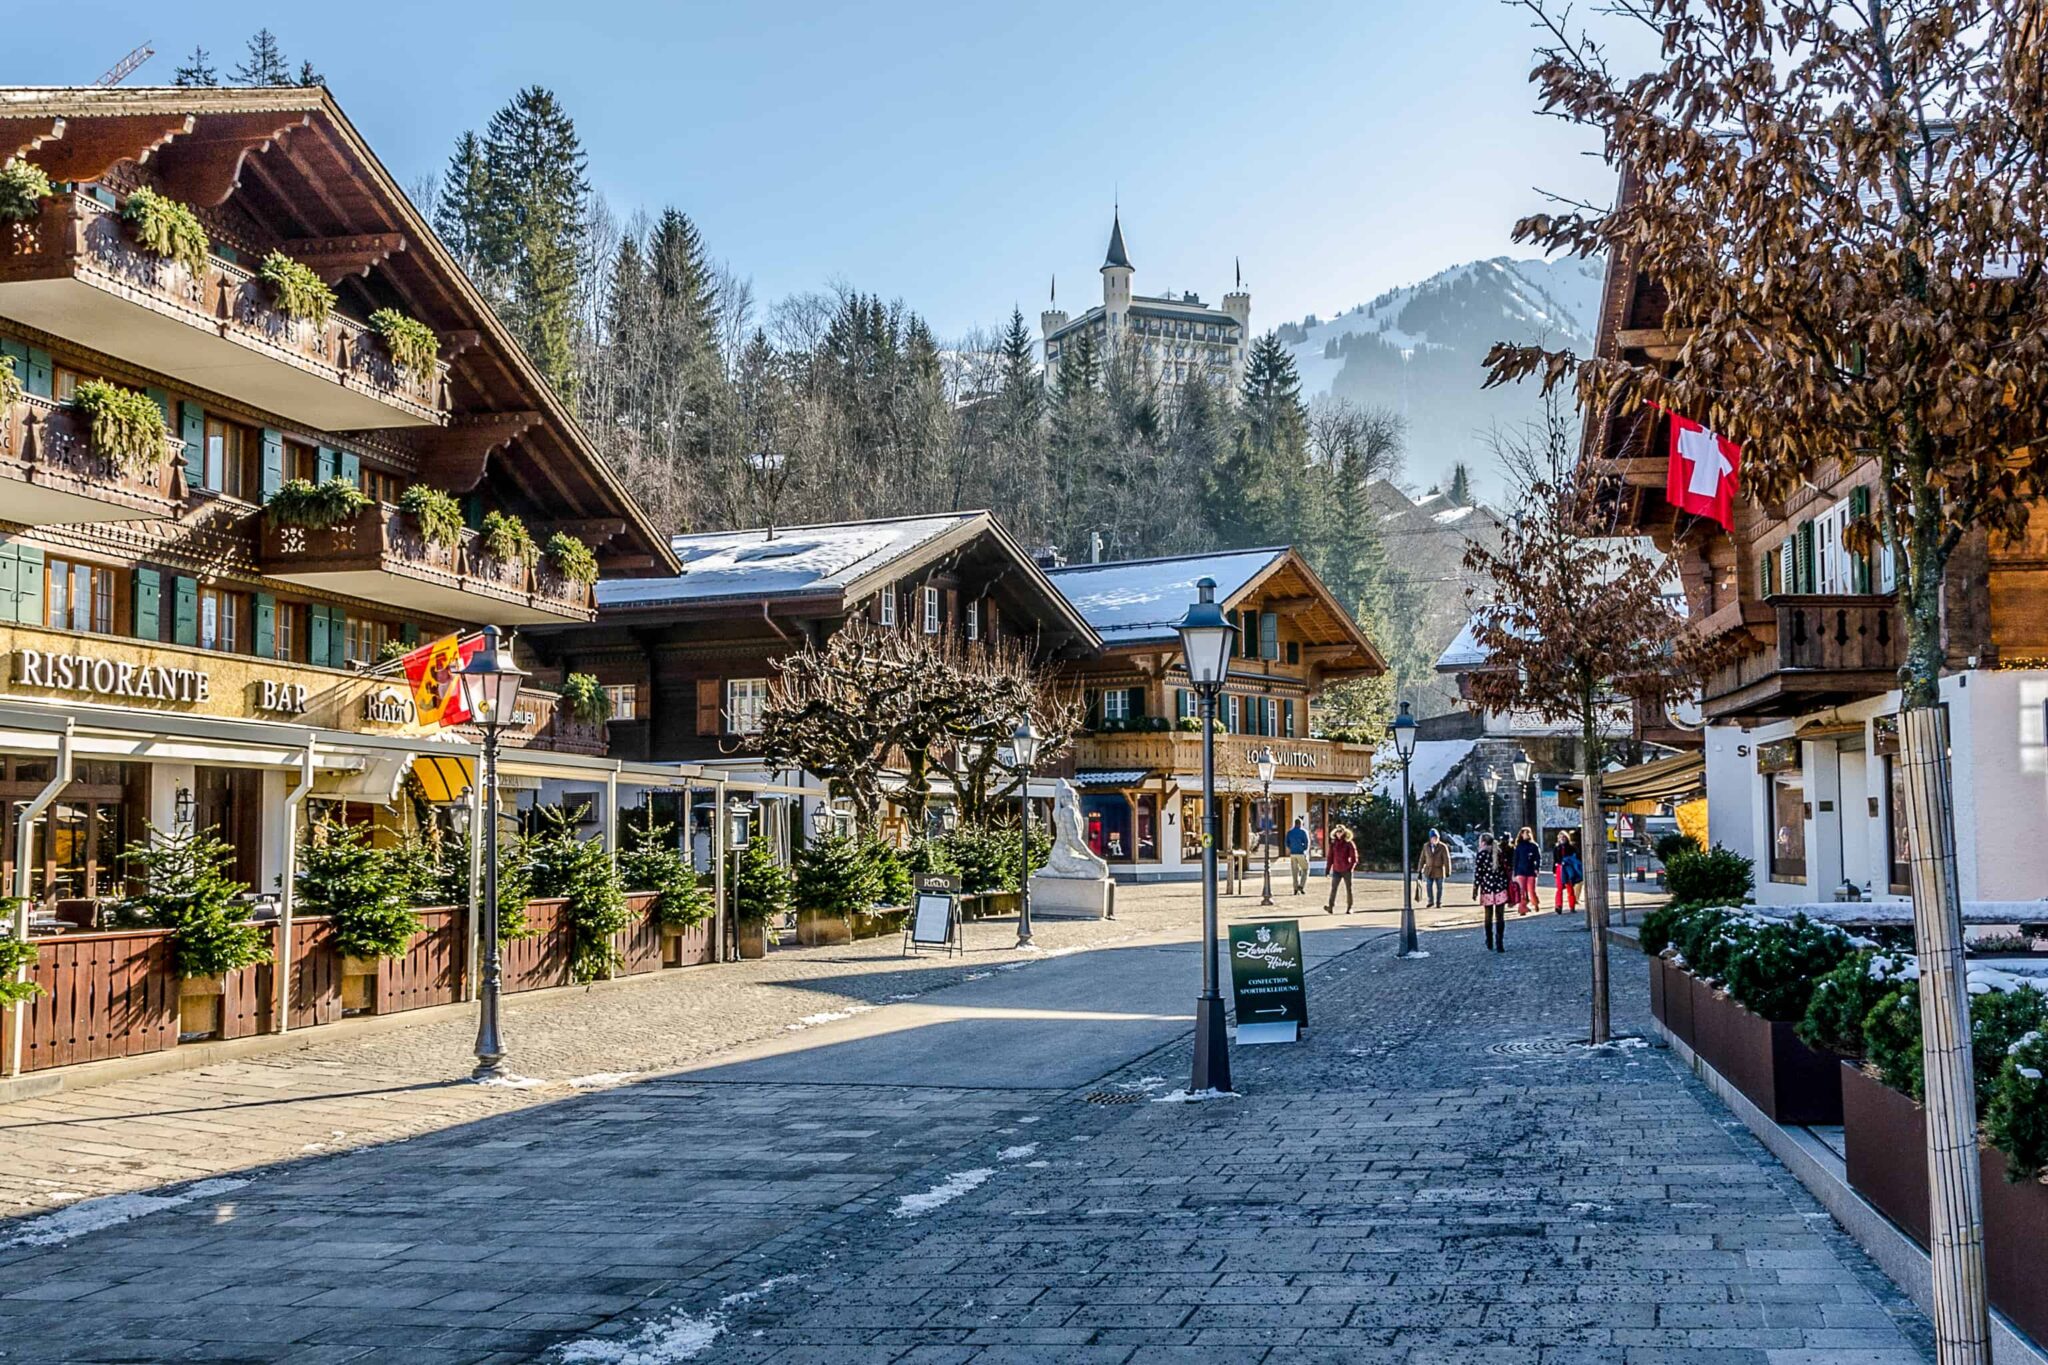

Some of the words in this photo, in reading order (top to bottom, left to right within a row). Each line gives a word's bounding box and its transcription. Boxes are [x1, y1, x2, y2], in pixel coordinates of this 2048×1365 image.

[20, 648, 211, 704] RISTORANTE
[262, 678, 308, 713] BAR
[365, 692, 416, 724] RIALTO
[1276, 751, 1316, 768] VUITTON
[923, 877, 950, 889] RIALTO
[1248, 976, 1289, 986] CONFECTION
